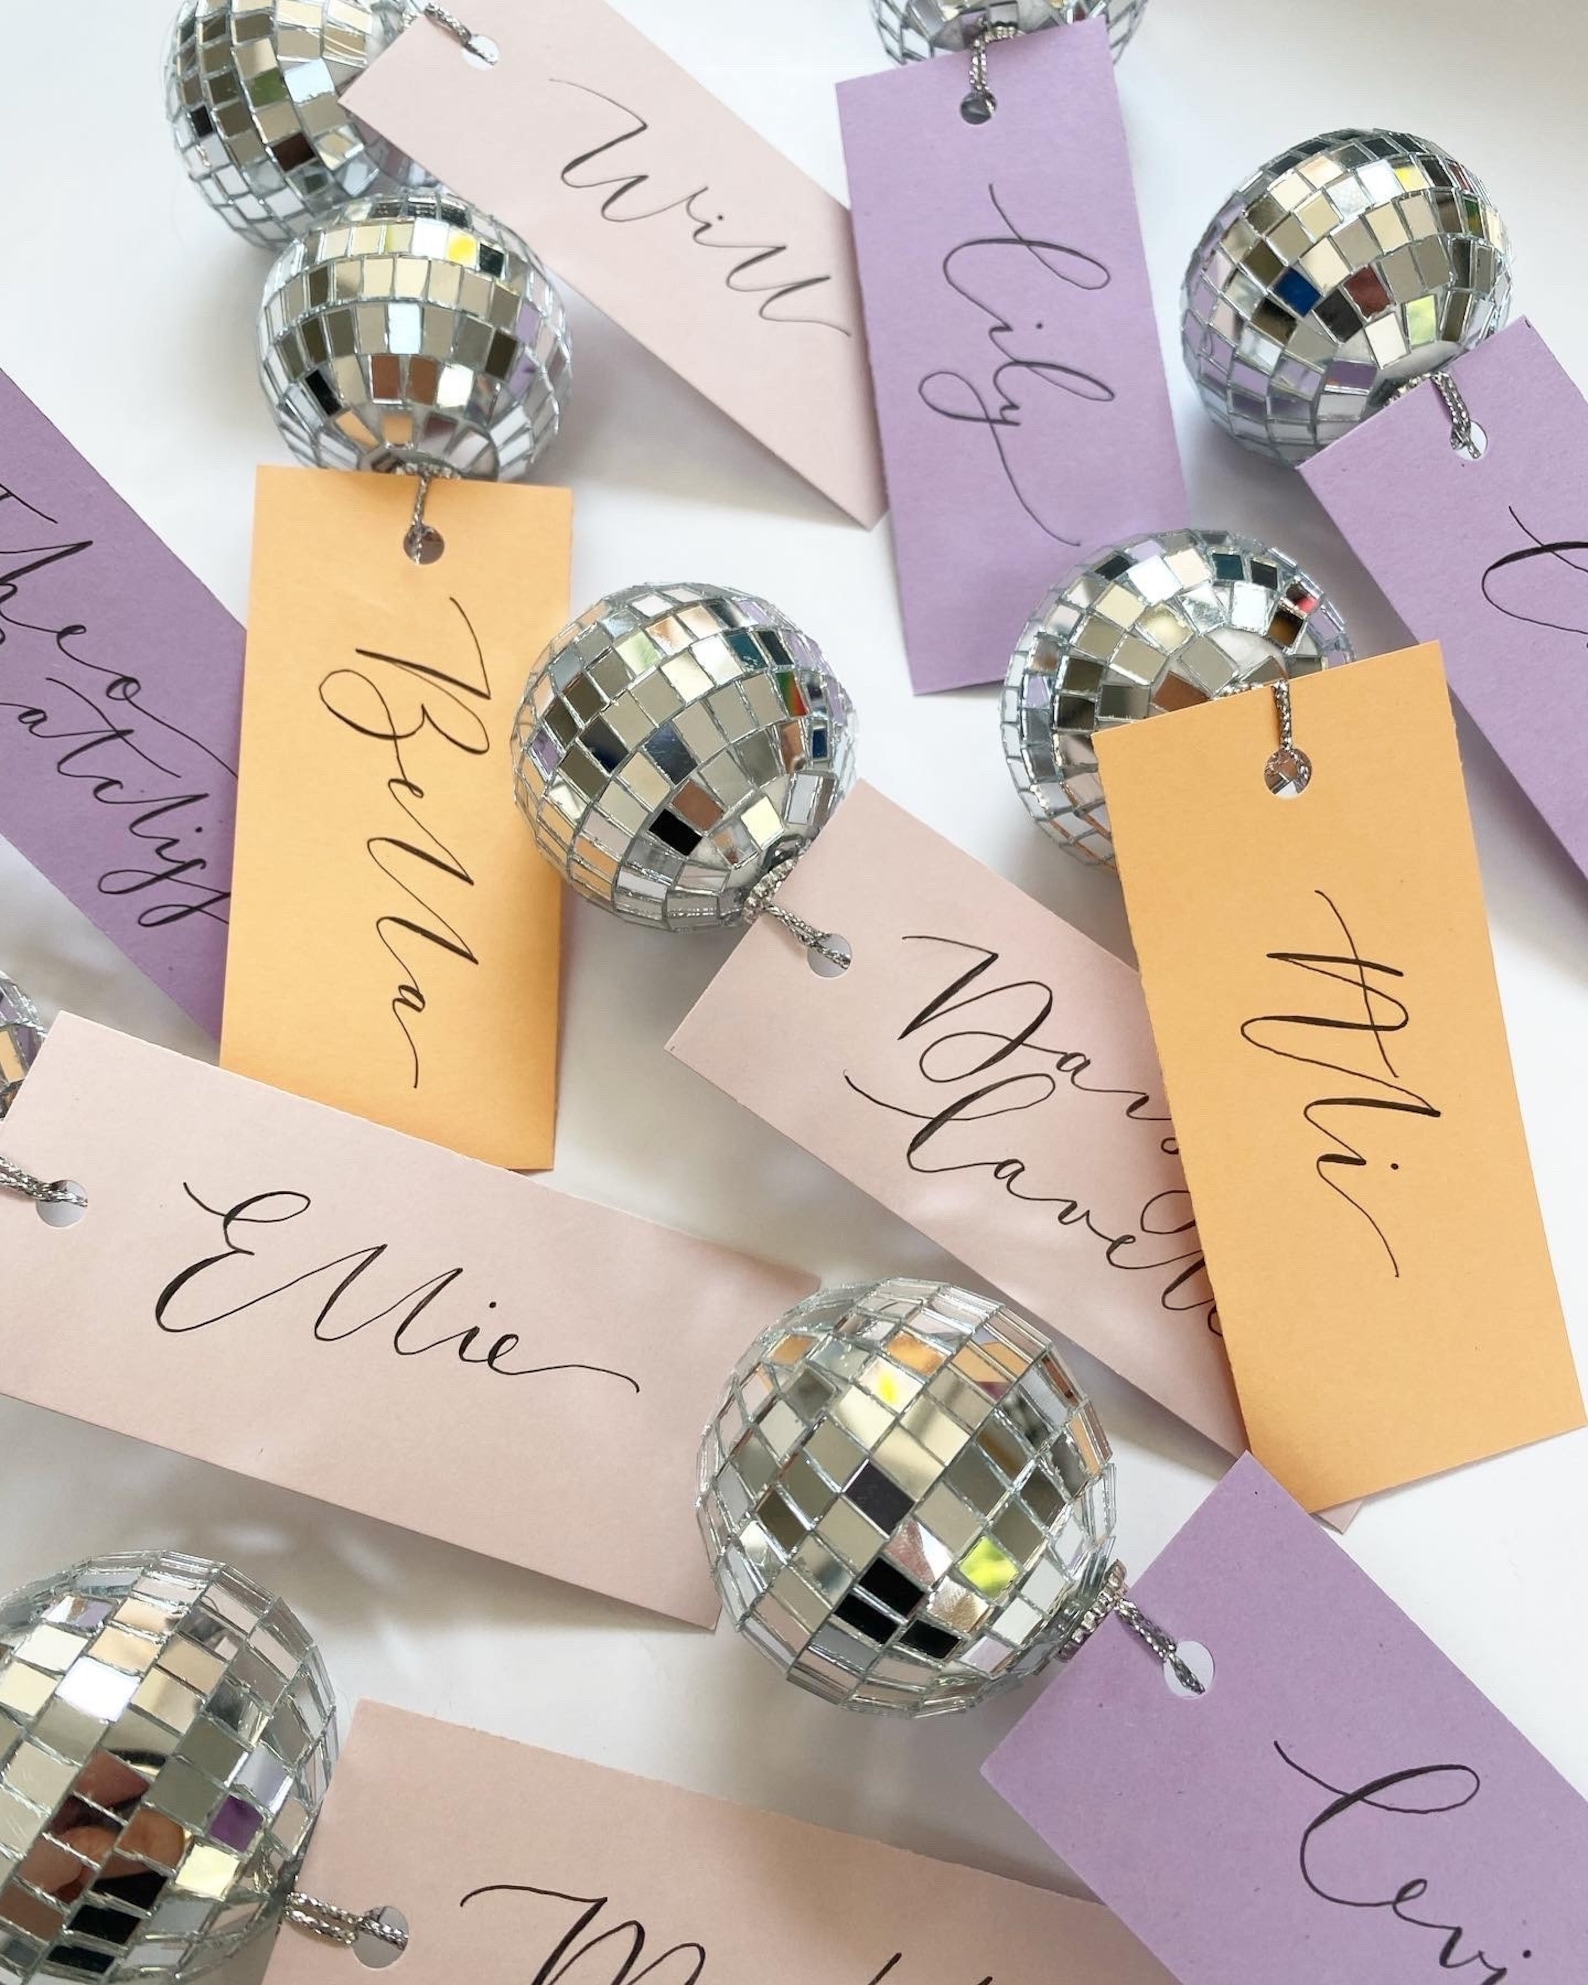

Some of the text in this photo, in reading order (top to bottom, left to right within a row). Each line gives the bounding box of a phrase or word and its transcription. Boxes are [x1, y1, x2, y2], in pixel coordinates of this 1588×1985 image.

[550, 79, 851, 337] Will
[918, 183, 1116, 547] Lily
[318, 596, 492, 1089] Bella
[155, 1182, 640, 1393] Ellie
